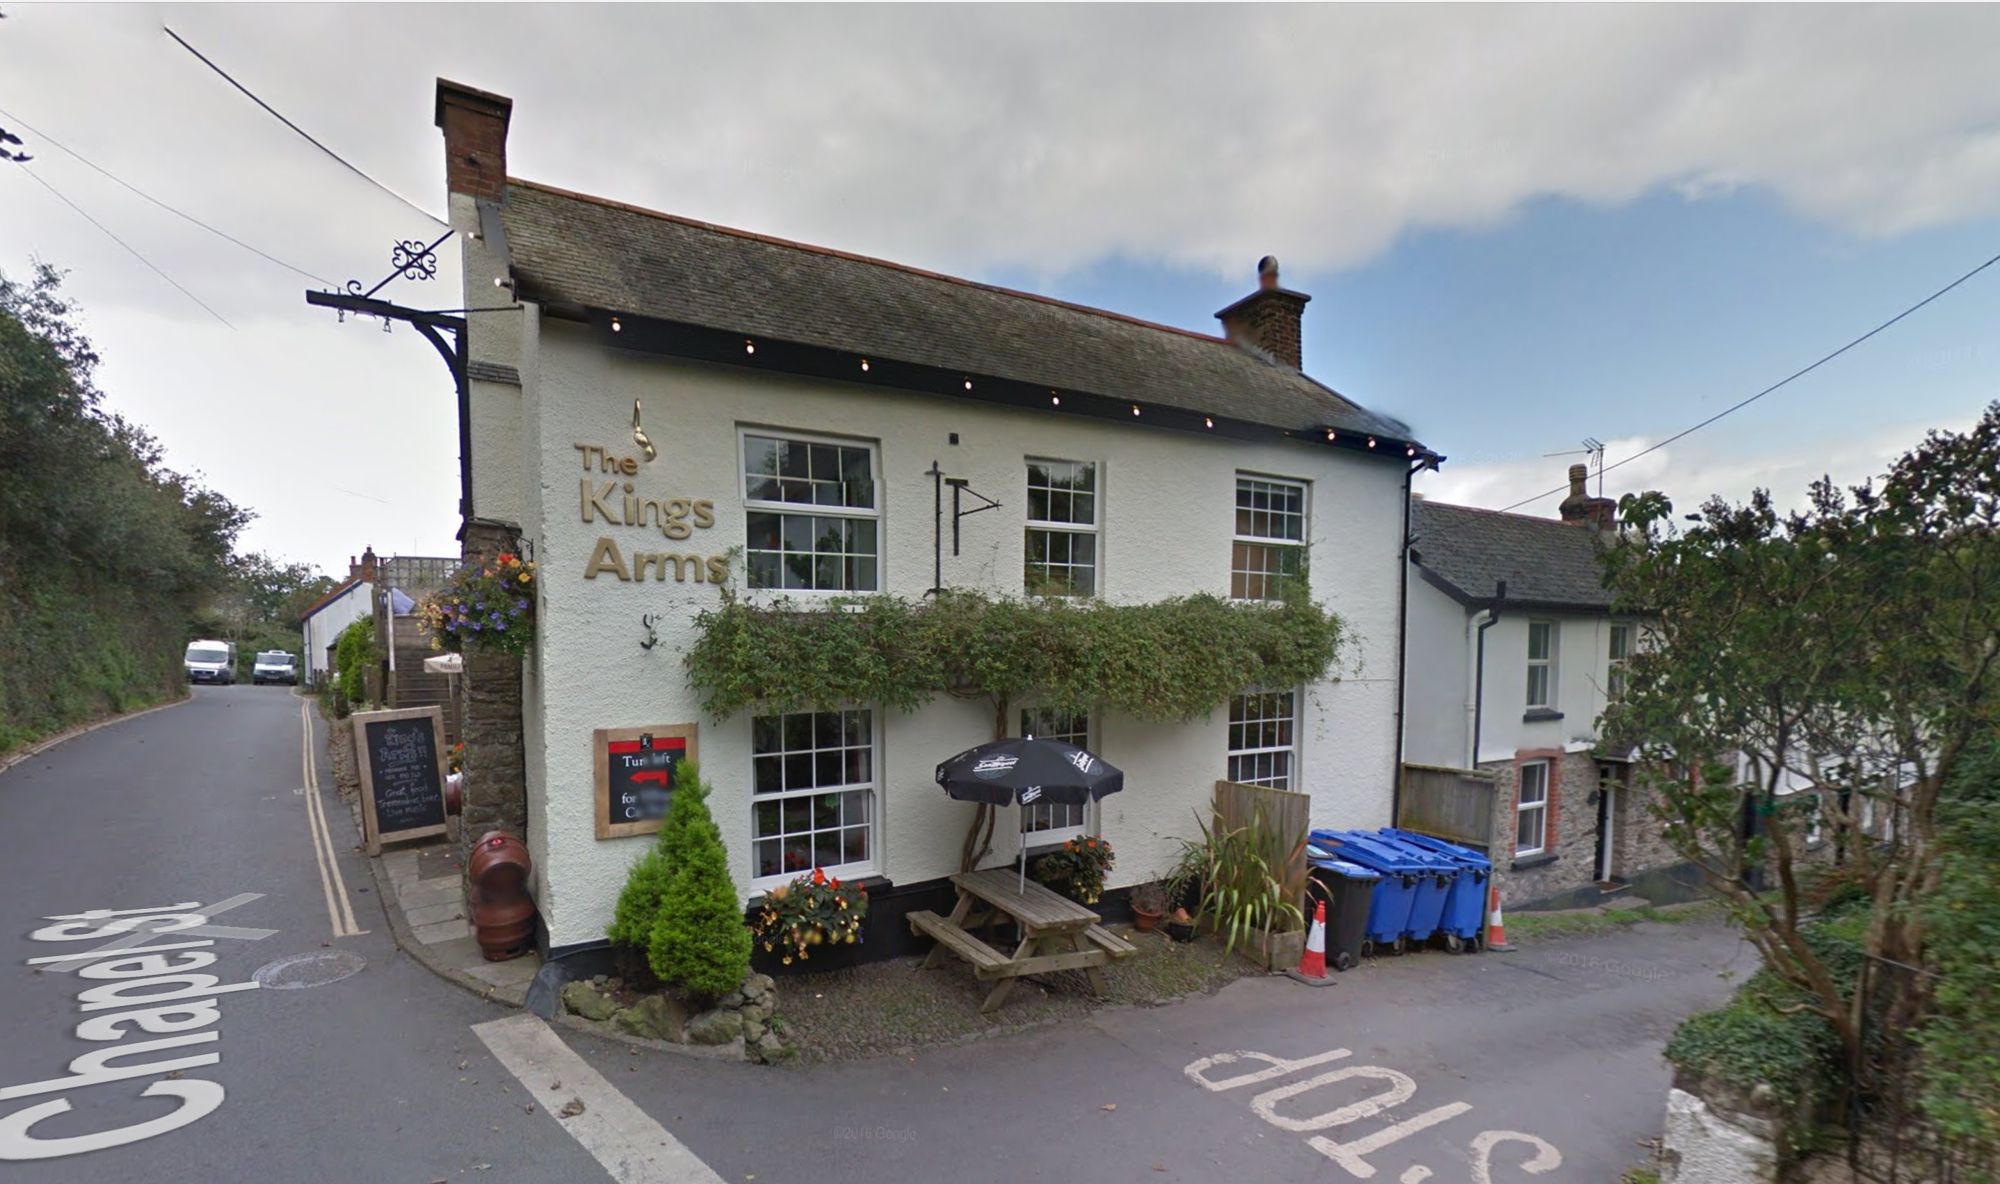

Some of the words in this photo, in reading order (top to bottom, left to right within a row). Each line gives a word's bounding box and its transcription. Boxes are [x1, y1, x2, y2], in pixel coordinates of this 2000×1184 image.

[575, 442, 638, 475] The
[580, 478, 715, 540] Kings
[584, 536, 729, 585] Arms
[622, 754, 650, 768] Tur
